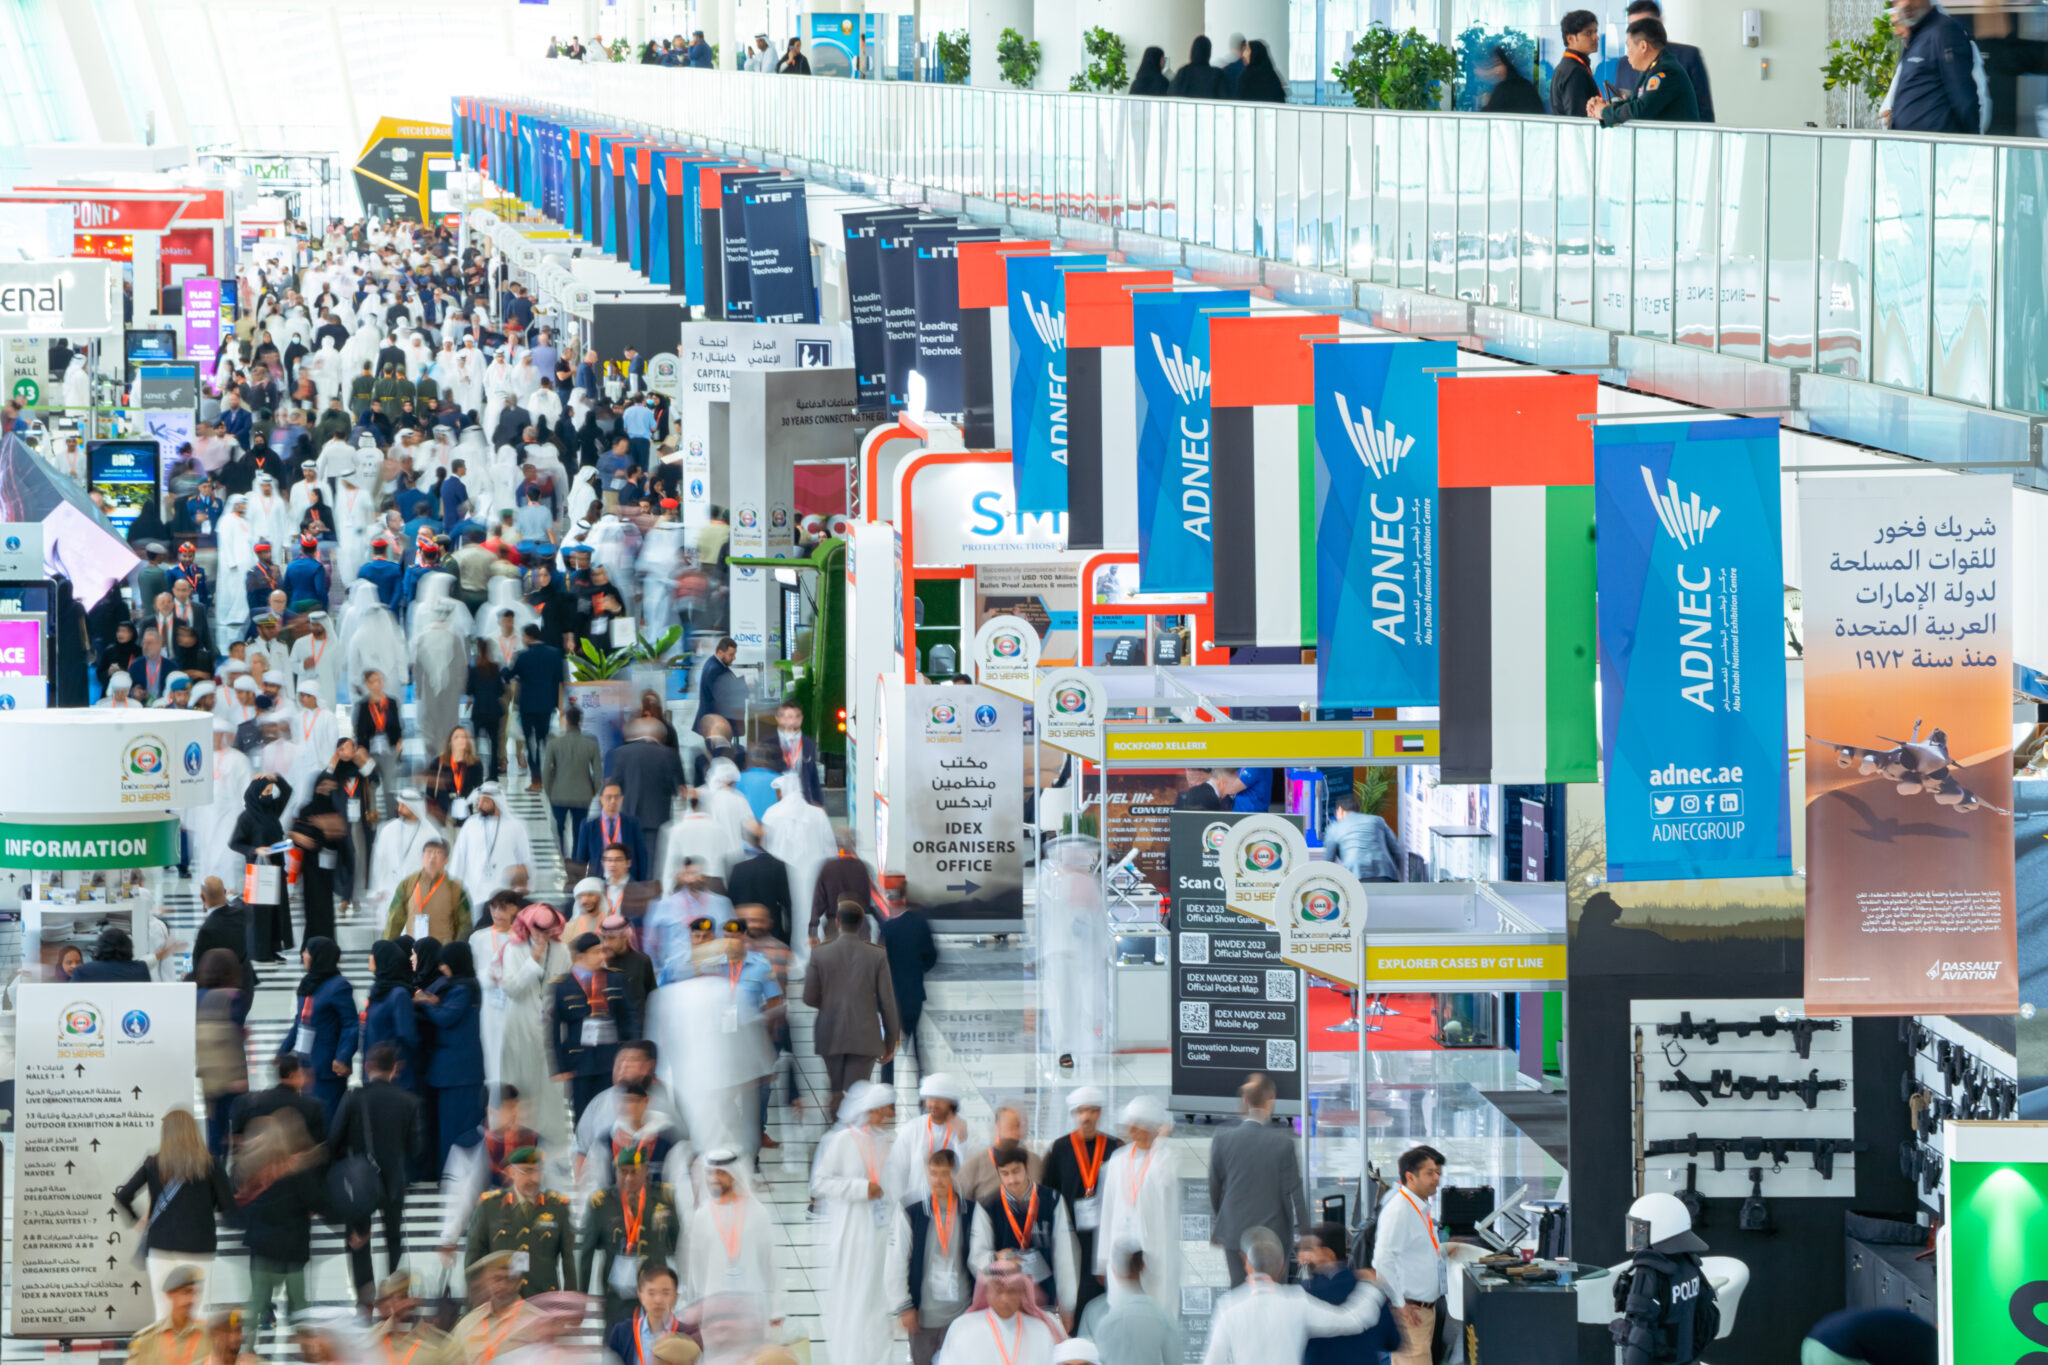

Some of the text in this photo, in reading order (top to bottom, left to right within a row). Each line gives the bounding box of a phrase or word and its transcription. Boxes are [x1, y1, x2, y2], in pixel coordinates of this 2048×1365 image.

[746, 192, 792, 204] LITEF
[66, 201, 110, 227] PONT
[848, 227, 876, 238] LIT
[750, 248, 779, 257] Leading
[752, 258, 777, 266] Inertial
[753, 266, 794, 275] Technology
[756, 314, 804, 324] LITEF
[920, 322, 958, 332] Leading
[699, 336, 728, 348] أجنحة
[920, 334, 954, 343] Inertial
[752, 340, 776, 350] المركز
[920, 346, 962, 356] Technol
[15, 356, 36, 365] قاعة
[705, 352, 736, 363] كابيتال
[748, 353, 780, 365] الإعلامي
[14, 368, 38, 376] HALL
[697, 369, 731, 378] CAPITAL
[17, 386, 35, 400] 13
[693, 383, 720, 392] SUITES
[144, 392, 167, 400] ADNEC
[782, 414, 875, 426] 30 YEARS CONNECTING THE
[1181, 416, 1211, 542] ADNEC
[1874, 515, 1996, 544] شريك فخور
[962, 542, 1057, 552] PROTECTING THOSE
[1423, 526, 1431, 566] Exhibition
[1830, 548, 1996, 574] للقوات المسلحة
[1370, 494, 1405, 645] ADNEC
[1719, 568, 1727, 593] مركز
[1856, 580, 1996, 610] لدولة الإمارات
[1424, 603, 1432, 627] Dhabi
[1730, 595, 1738, 634] Exhibition
[1835, 613, 1996, 640] العربية المتحدة
[734, 634, 762, 643] ADNEC
[1424, 629, 1432, 645] Abu
[1677, 564, 1714, 713] ADNEC
[1731, 635, 1739, 669] National
[1856, 647, 1997, 669] منذ سنة ١٩٧٢
[1000, 672, 1030, 680] YEARS
[1732, 671, 1740, 694] Dhabi
[1114, 741, 1207, 750] ROCKFORD XELLERIX
[940, 757, 987, 771] مكتب
[1650, 763, 1743, 786] adnec.ae
[932, 777, 996, 791] منظمين
[121, 792, 170, 803] 30 YEARS
[946, 822, 982, 834] IDEX
[1652, 821, 1745, 842] ADNECGROUP
[5, 839, 147, 857] INFORMATION
[913, 841, 1016, 854] ORGANISERS
[936, 860, 992, 872] OFFICE
[1179, 876, 1210, 889] Scan
[1235, 892, 1252, 902] 30
[1187, 905, 1225, 914] IDEX 2023
[1186, 914, 1213, 922] Official
[1215, 915, 1234, 923] Show
[1214, 940, 1266, 949] NAVDEX 2023
[1290, 942, 1352, 953] 30 YEARS
[1214, 950, 1263, 959] Official Show
[1378, 957, 1544, 969] EXPLORER CASES BY GT LINE
[1942, 961, 2002, 971] DASSAULT
[1187, 973, 1258, 983] IDEX NAVDEX 2023
[1941, 971, 1997, 980] AVIATION
[1187, 983, 1259, 994] Official Pocket Map
[1214, 1010, 1286, 1020] IDEX NAVDEX 2023
[1215, 1020, 1259, 1030] Mobile App
[1187, 1043, 1259, 1054] Innovation Journey
[1187, 1053, 1211, 1061] Guide
